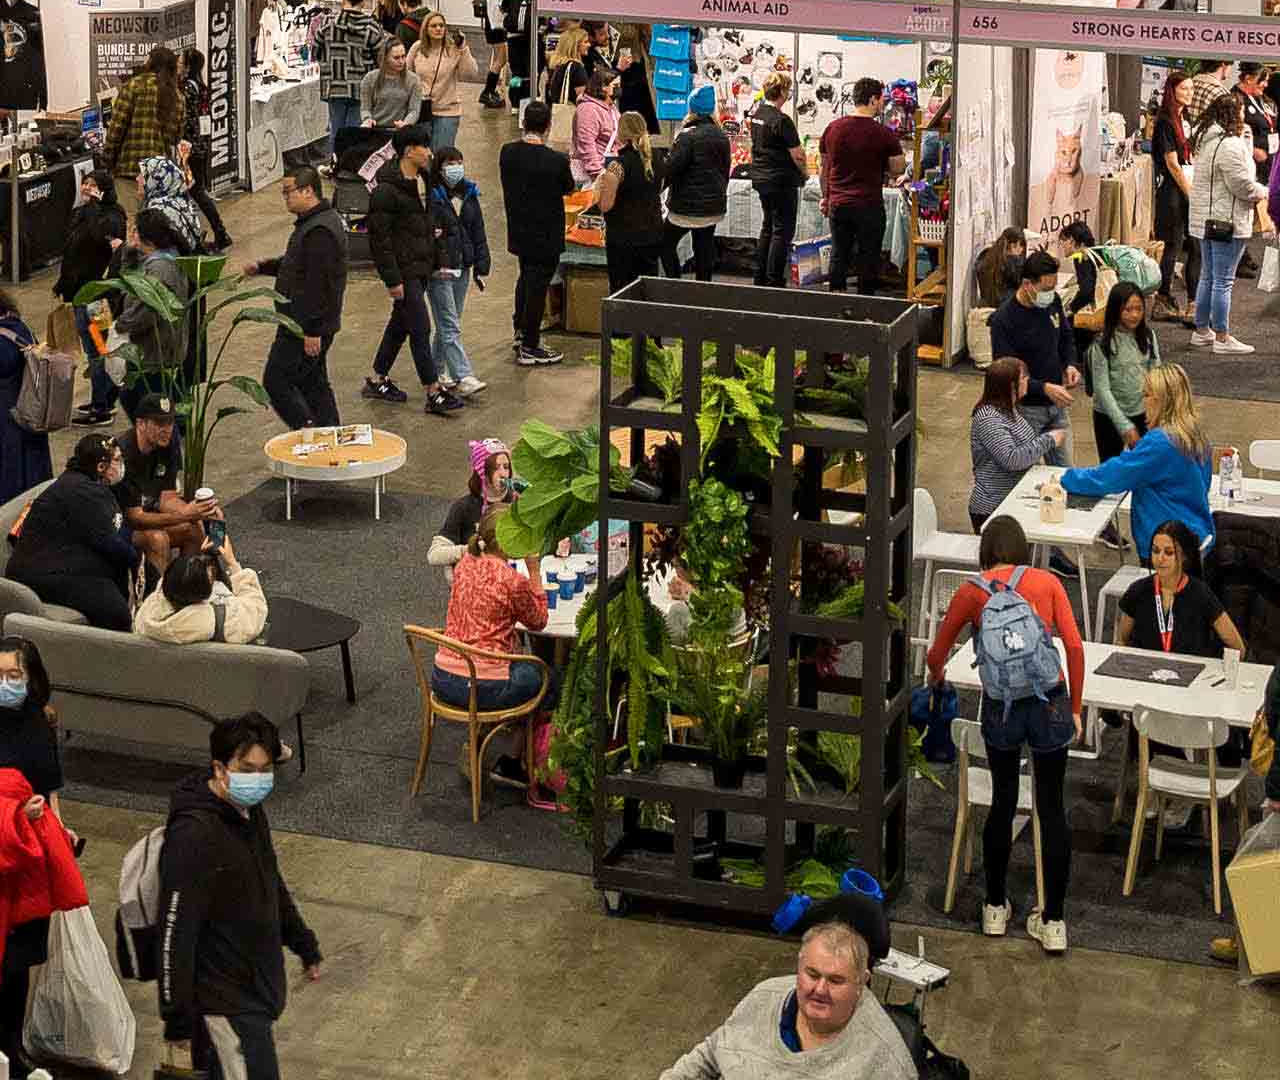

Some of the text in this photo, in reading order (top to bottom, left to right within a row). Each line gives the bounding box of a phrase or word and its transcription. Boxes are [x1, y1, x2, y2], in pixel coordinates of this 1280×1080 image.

[764, 1, 790, 17] AID
[972, 16, 999, 29] 656
[1072, 20, 1136, 37] STRONG
[1139, 24, 1197, 41] HEARTS
[1200, 27, 1234, 43] CAT
[97, 43, 137, 56] BUNDLE
[1039, 208, 1091, 234] ADOPT
